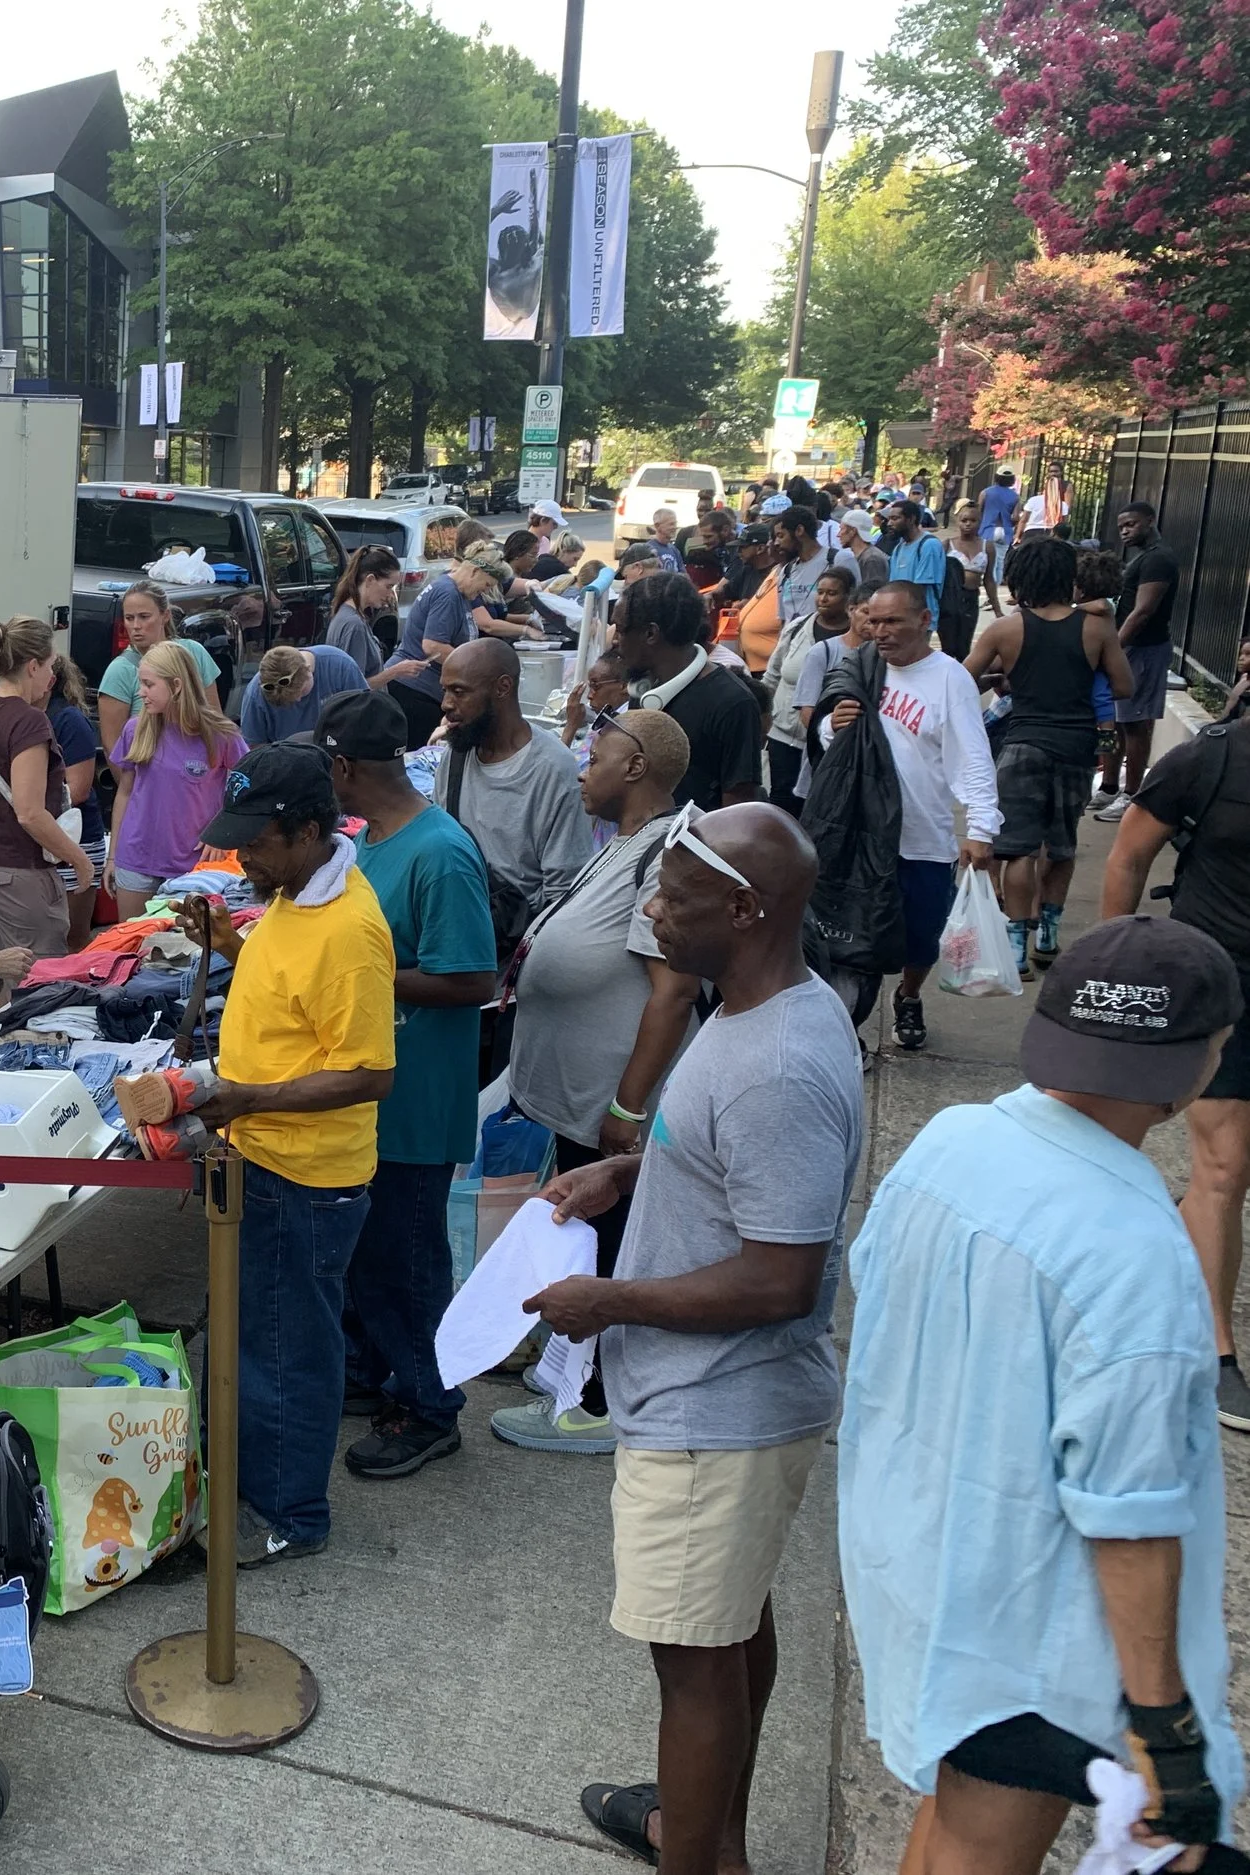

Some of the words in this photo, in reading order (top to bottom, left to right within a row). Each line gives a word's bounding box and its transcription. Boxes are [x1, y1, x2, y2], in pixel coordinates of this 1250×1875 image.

[595, 163, 607, 228] SEASON
[591, 231, 604, 326] UNFILTERED
[539, 394, 549, 405] P
[525, 451, 552, 460] 45110
